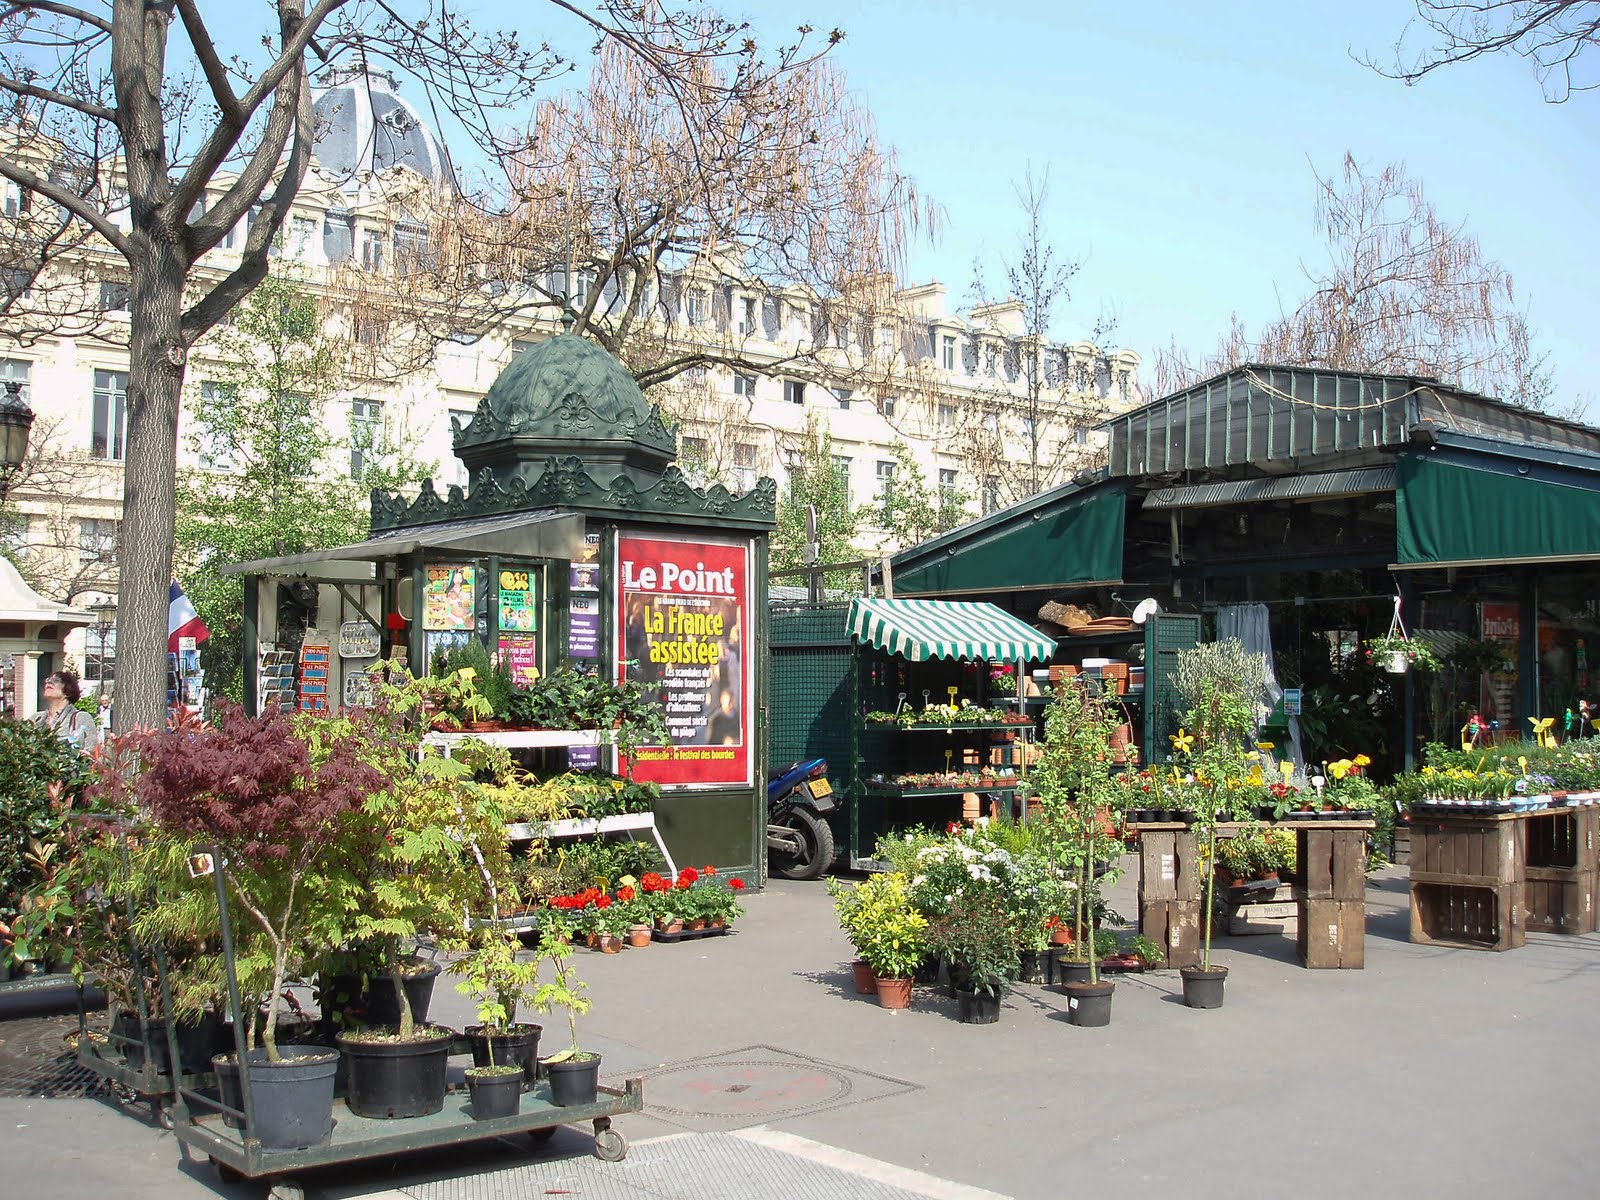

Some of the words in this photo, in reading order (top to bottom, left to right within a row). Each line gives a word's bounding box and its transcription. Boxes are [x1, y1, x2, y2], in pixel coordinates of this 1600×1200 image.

[622, 561, 657, 590] Le
[661, 562, 734, 594] Point
[503, 596, 510, 606] 2
[644, 605, 664, 634] La
[668, 606, 724, 636] France
[650, 635, 719, 664] assistée
[665, 667, 674, 676] Les
[675, 668, 702, 677] scandales
[684, 678, 706, 689] français
[668, 692, 677, 701] Les
[666, 703, 702, 712] d'allocations
[665, 716, 692, 726] Comment
[692, 716, 708, 726] sortir
[680, 750, 700, 760] festival
[701, 750, 711, 759] des
[712, 750, 735, 760] bourdes
[1172, 926, 1180, 948] BERG
[1328, 924, 1338, 946] BERG
